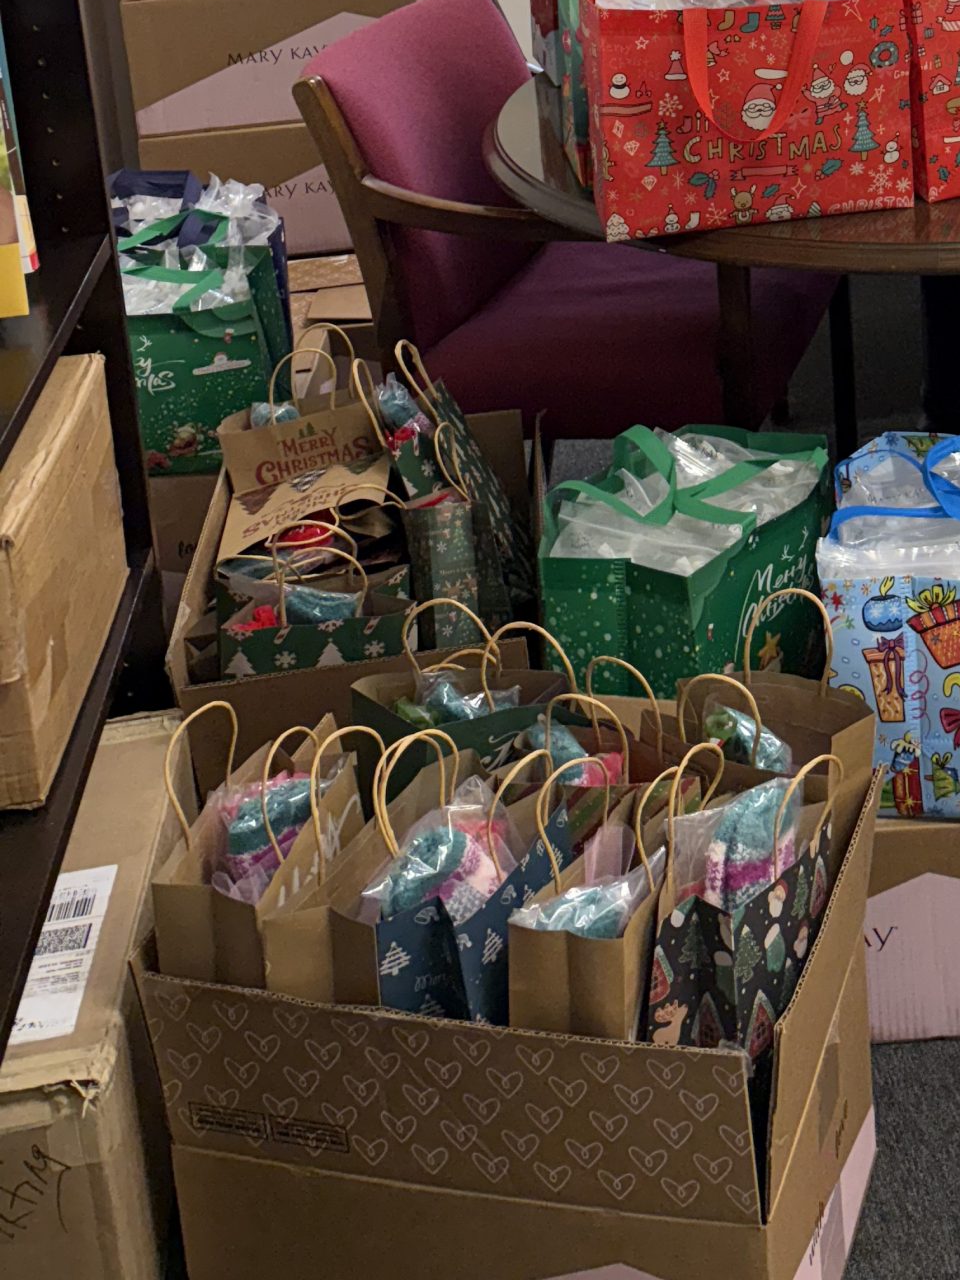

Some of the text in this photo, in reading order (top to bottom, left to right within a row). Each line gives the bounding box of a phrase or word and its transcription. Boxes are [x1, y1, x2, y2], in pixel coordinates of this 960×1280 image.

[226, 48, 283, 66] MARY
[683, 124, 843, 164] CHRISTMAS
[263, 183, 298, 199] ARY
[278, 426, 337, 459] MERRY
[254, 436, 371, 487] CHRISTMAS
